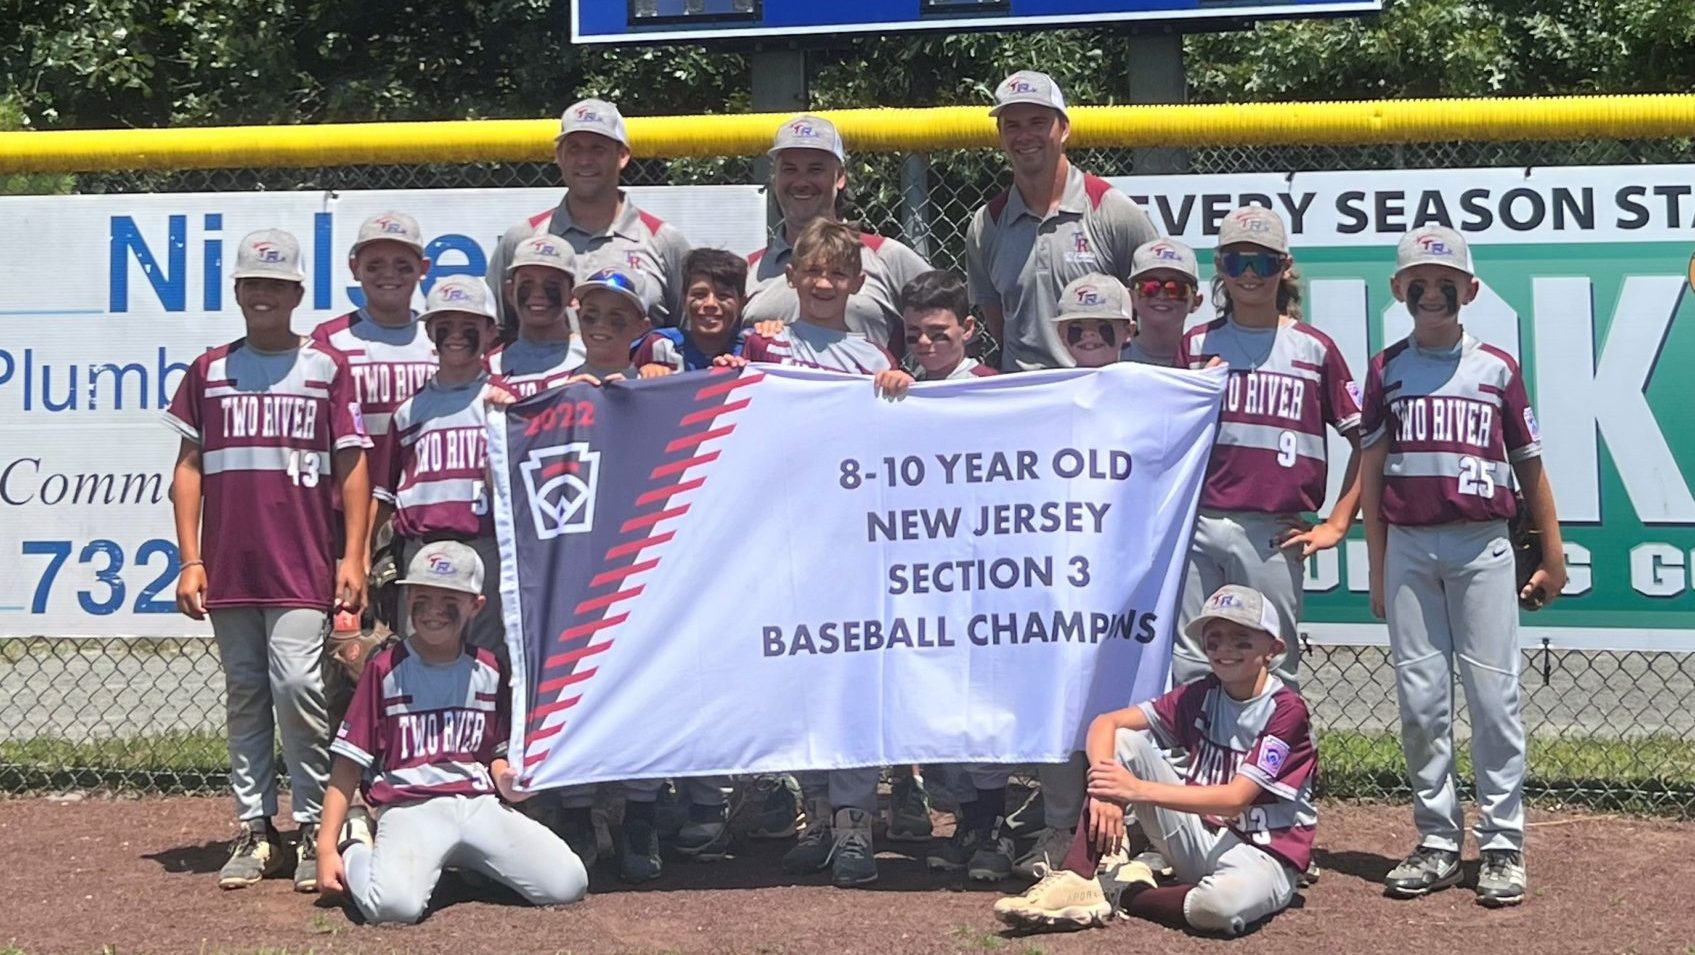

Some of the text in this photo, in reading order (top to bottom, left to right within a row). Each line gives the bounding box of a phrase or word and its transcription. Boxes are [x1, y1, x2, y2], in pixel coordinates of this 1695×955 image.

[1128, 185, 1695, 236] VEY SEASON ST
[351, 364, 390, 404] TWO
[1244, 373, 1305, 421] RIVER
[221, 396, 318, 440] TWO RIVER
[1433, 398, 1493, 449] RIVER
[287, 450, 321, 488] 43
[839, 448, 1133, 489] 8-10 YEAR OLD
[1277, 431, 1298, 468] 9
[0, 456, 173, 506] Comm
[1458, 456, 1498, 499] 25
[867, 502, 1112, 542] NEW JERSEY
[22, 538, 182, 615] 732
[888, 555, 1091, 595] SECTION 3
[762, 616, 955, 657] BASEBALL
[399, 714, 440, 760] TWO
